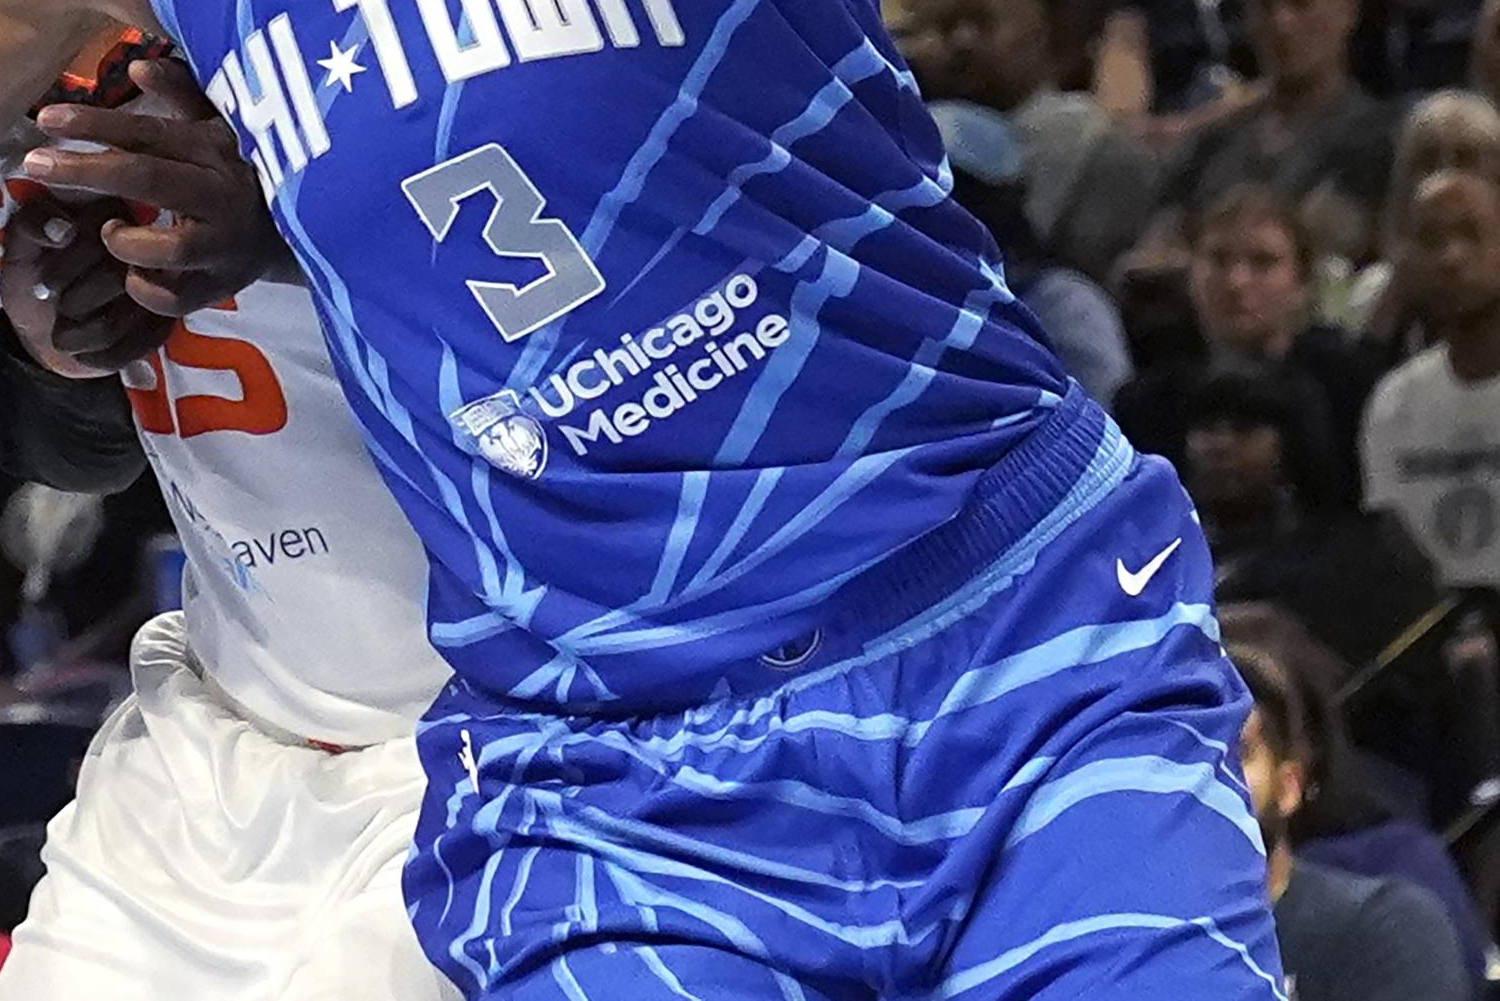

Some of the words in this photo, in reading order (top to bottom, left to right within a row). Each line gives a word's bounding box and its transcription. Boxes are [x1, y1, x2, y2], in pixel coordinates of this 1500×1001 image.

[401, 142, 606, 343] 3
[528, 273, 758, 418] UChicago
[557, 314, 791, 456] Medicine
[231, 525, 329, 569] aven
